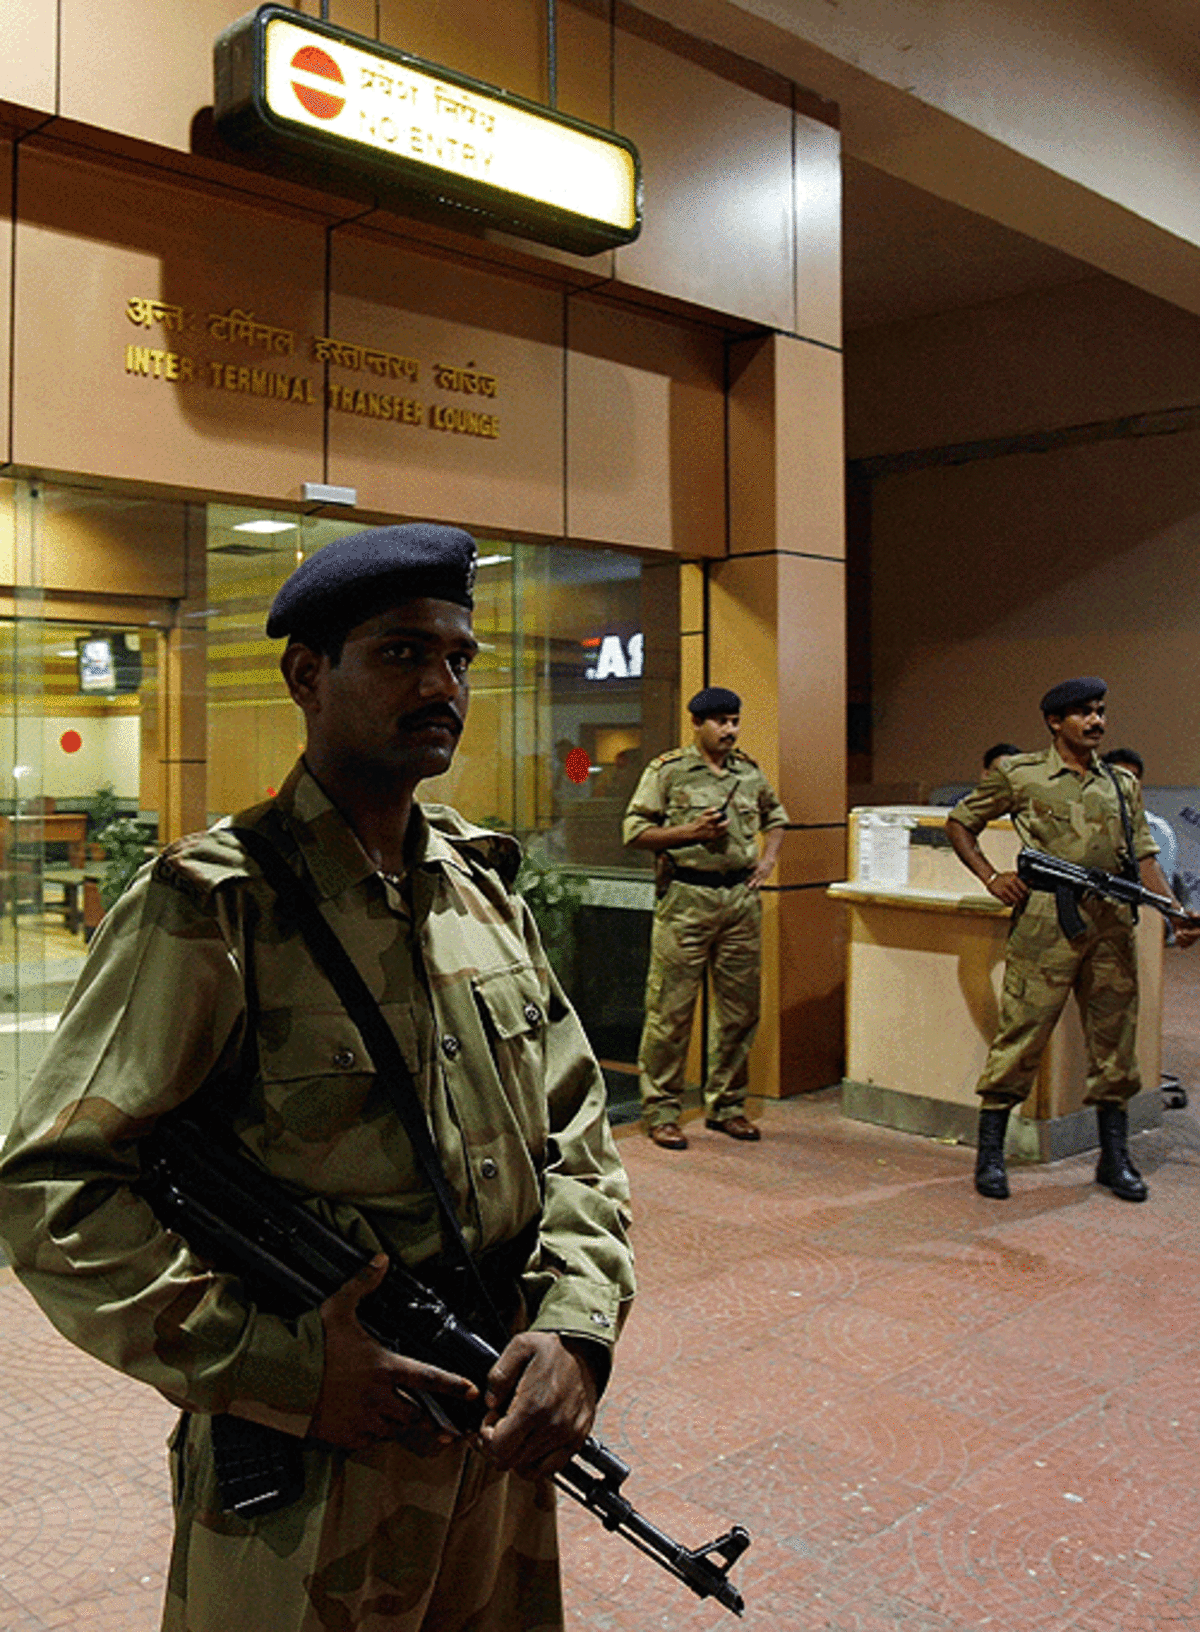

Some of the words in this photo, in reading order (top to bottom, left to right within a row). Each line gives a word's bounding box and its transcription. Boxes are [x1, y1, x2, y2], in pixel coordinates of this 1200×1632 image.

[359, 110, 398, 144] NO
[409, 126, 495, 175] ENTRY
[208, 309, 294, 354] टर्मिनल
[126, 344, 193, 382] INTER
[209, 362, 317, 404] TERMINAL
[328, 384, 424, 425] TRANSFER
[431, 405, 501, 439] LOUNGE
